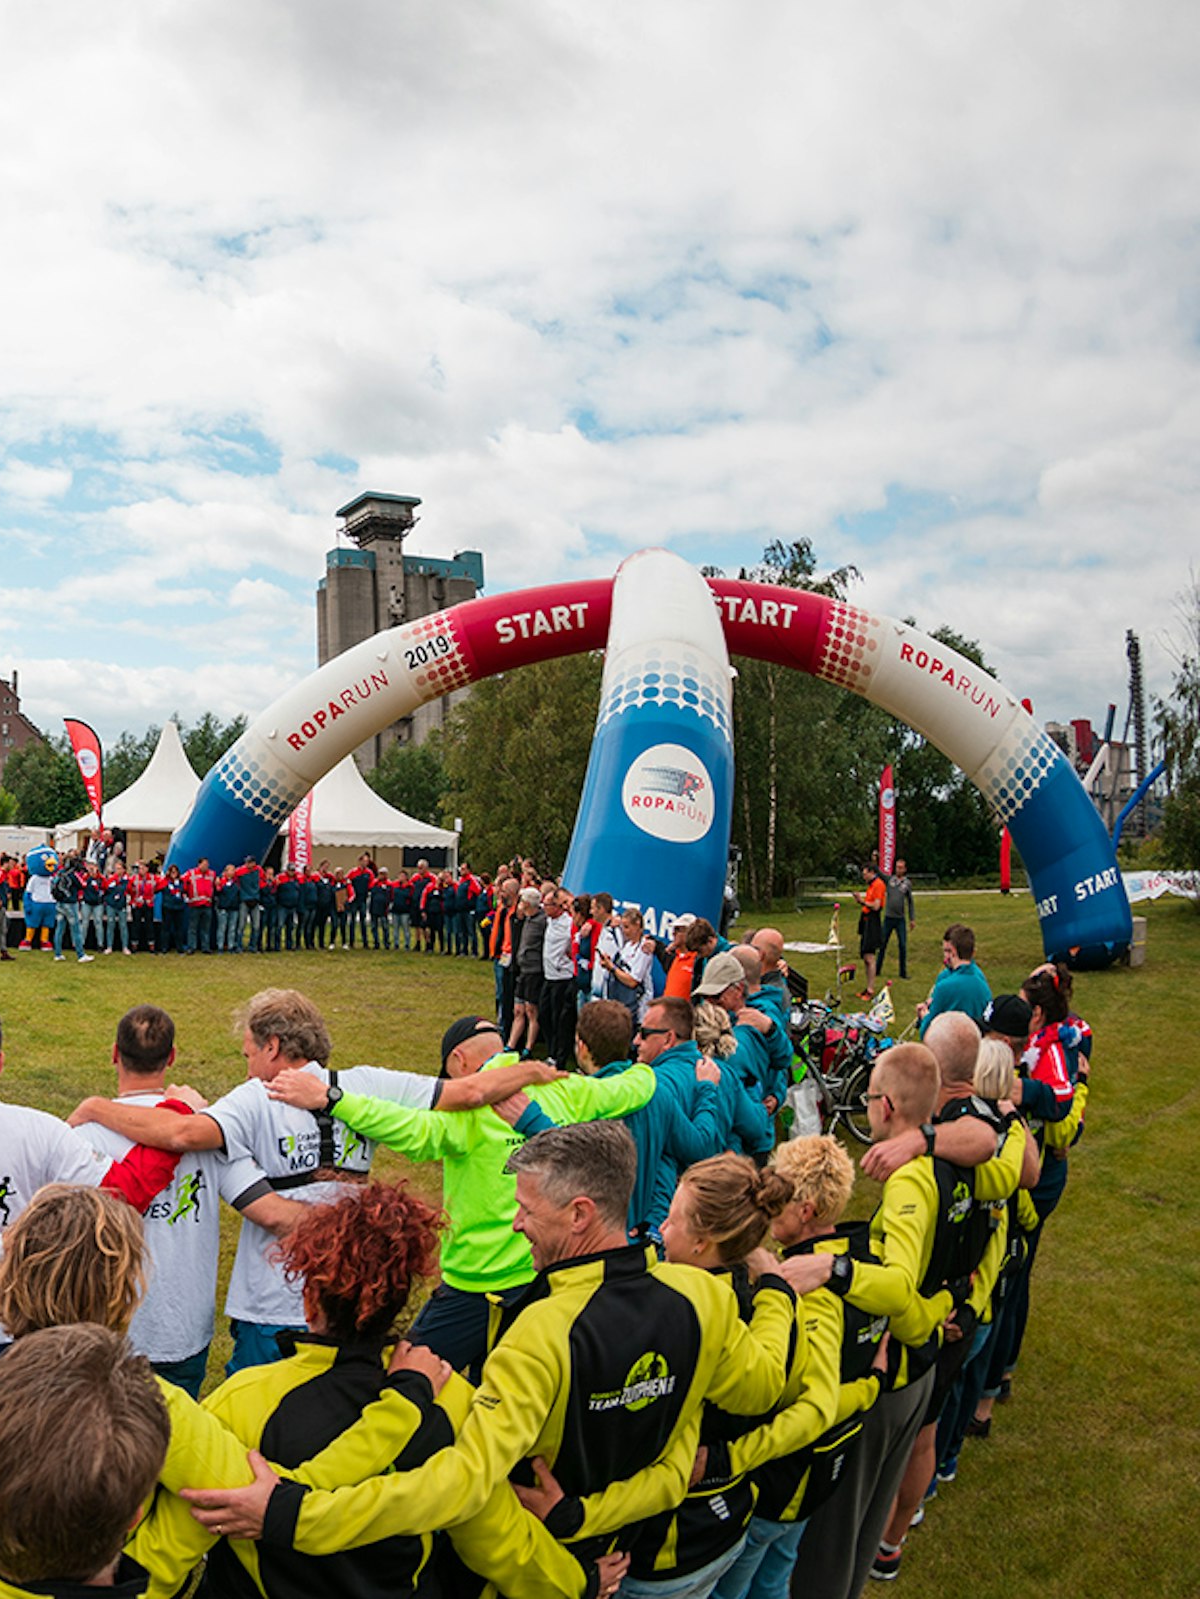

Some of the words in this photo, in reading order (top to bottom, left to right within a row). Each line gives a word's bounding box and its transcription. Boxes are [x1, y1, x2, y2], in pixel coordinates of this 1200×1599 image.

[494, 602, 589, 644] START
[404, 635, 451, 670] 2019
[900, 642, 1001, 719] ROPARUN
[286, 669, 390, 751] ROPARUN
[631, 795, 709, 826] ROPARUN
[883, 813, 896, 873] ROPARUN
[1074, 866, 1119, 902] START
[589, 1397, 620, 1411] TEAM
[620, 1377, 668, 1405] ZUTPHEN
